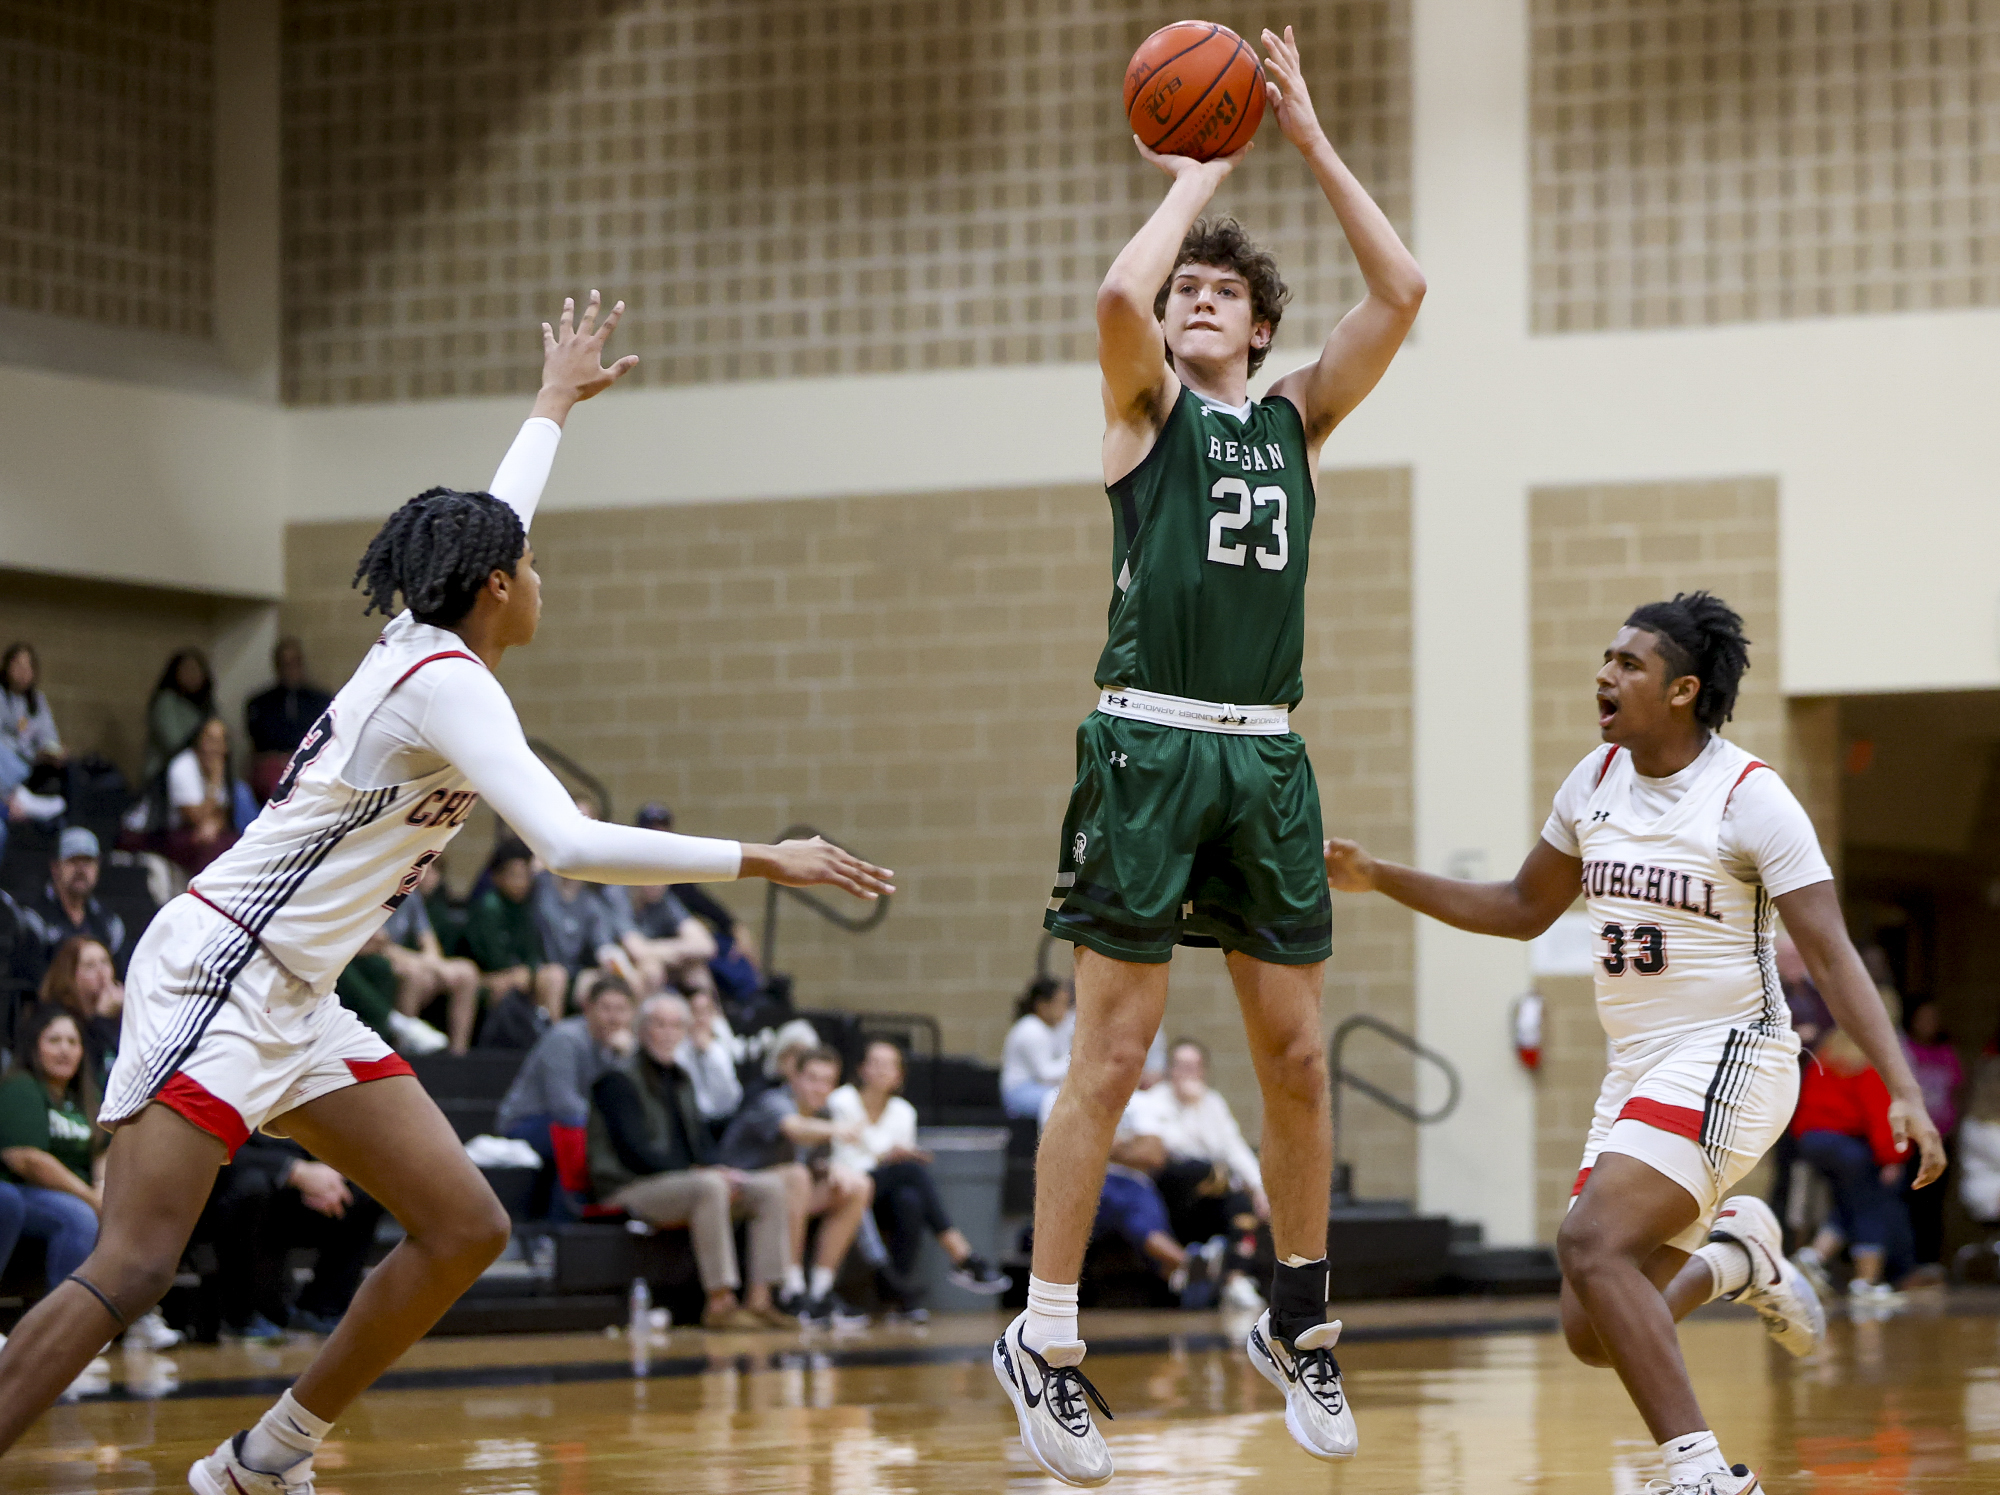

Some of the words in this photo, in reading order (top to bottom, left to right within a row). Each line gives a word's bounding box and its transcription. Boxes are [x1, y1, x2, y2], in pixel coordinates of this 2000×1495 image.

[1144, 76, 1182, 119] ELITE
[1208, 435, 1285, 471] REGAN
[1207, 477, 1288, 571] 23
[1131, 702, 1175, 715] ARMOUR
[1179, 709, 1213, 721] UNDER
[1600, 921, 1668, 977] 33
